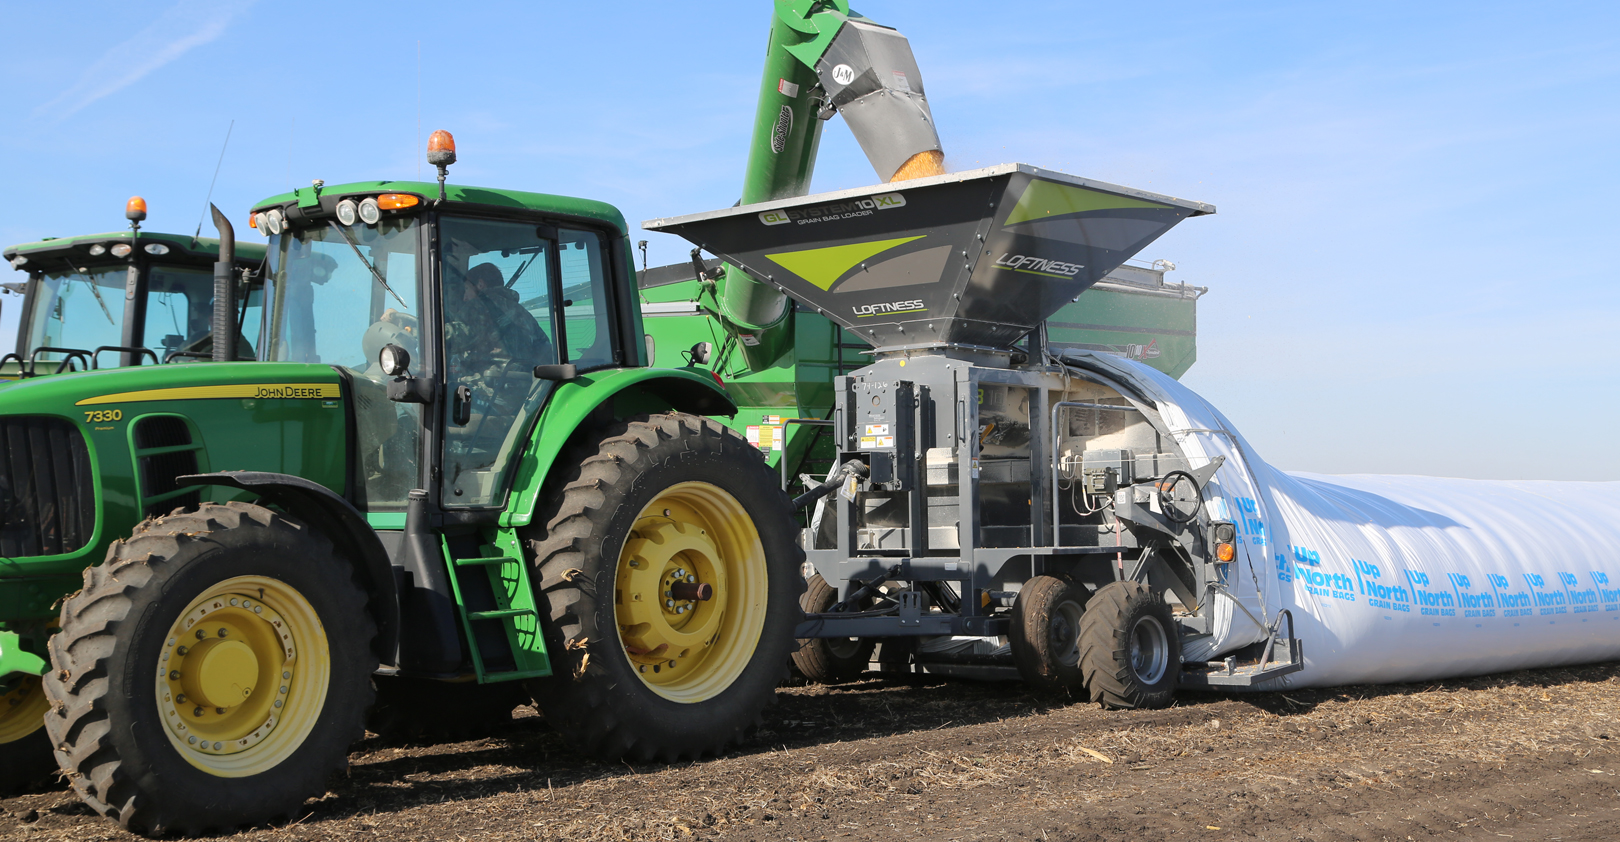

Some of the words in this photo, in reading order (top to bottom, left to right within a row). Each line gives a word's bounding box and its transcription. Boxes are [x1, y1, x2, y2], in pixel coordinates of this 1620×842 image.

[834, 67, 853, 83] J&M
[763, 213, 788, 223] GL
[879, 196, 902, 207] XL
[797, 217, 822, 225] GRAIN
[841, 210, 874, 219] LOADER
[995, 252, 1085, 276] LOFTNESS
[852, 299, 925, 316] LOFTNESS
[255, 386, 284, 397] JOHN
[285, 386, 322, 397] DEERE
[84, 409, 122, 423] 7330
[1294, 545, 1320, 566] Up
[1358, 560, 1381, 579] Up
[1296, 565, 1354, 591] North
[1408, 570, 1430, 587] Up
[1452, 573, 1471, 590] Up
[1491, 573, 1509, 590] Up
[1527, 573, 1545, 589] Up
[1561, 572, 1578, 587] Up
[1593, 571, 1609, 586] Up
[1333, 590, 1355, 601] BAGS
[1366, 580, 1409, 603] North
[1417, 590, 1455, 607] North
[1461, 591, 1494, 608] North
[1500, 591, 1531, 608] North
[1536, 590, 1566, 606] North
[1570, 588, 1597, 604] North
[1369, 598, 1391, 609] GRAIN
[1393, 603, 1410, 613] BAGS
[1421, 607, 1439, 616] GRAIN
[1441, 608, 1456, 616] BAGS
[1465, 609, 1481, 617] GRAIN
[1482, 609, 1496, 617] BAGS
[1504, 609, 1519, 617] GRAIN
[1520, 608, 1532, 616] BAGS
[1540, 608, 1554, 616] GRAIN
[1555, 606, 1567, 614] BAGS
